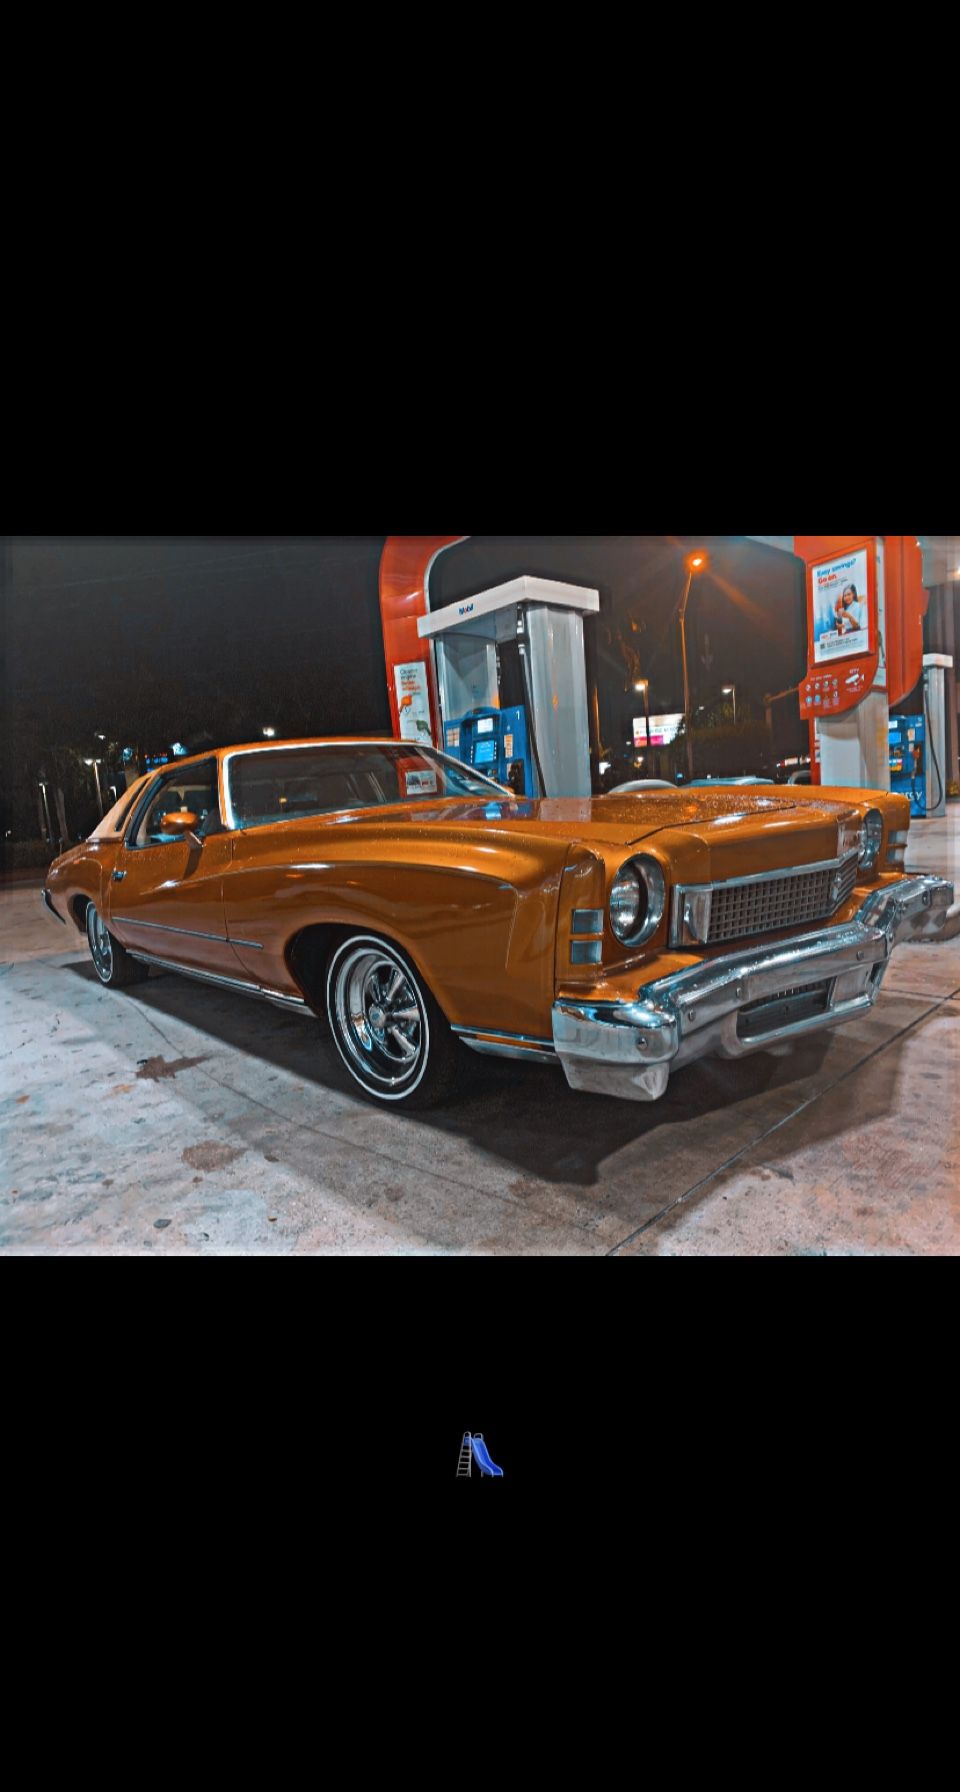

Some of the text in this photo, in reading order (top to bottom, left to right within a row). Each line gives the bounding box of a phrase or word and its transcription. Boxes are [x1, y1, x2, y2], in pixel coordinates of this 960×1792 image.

[816, 568, 831, 577] Easy
[458, 602, 474, 615] Mobil
[515, 709, 521, 721] 1
